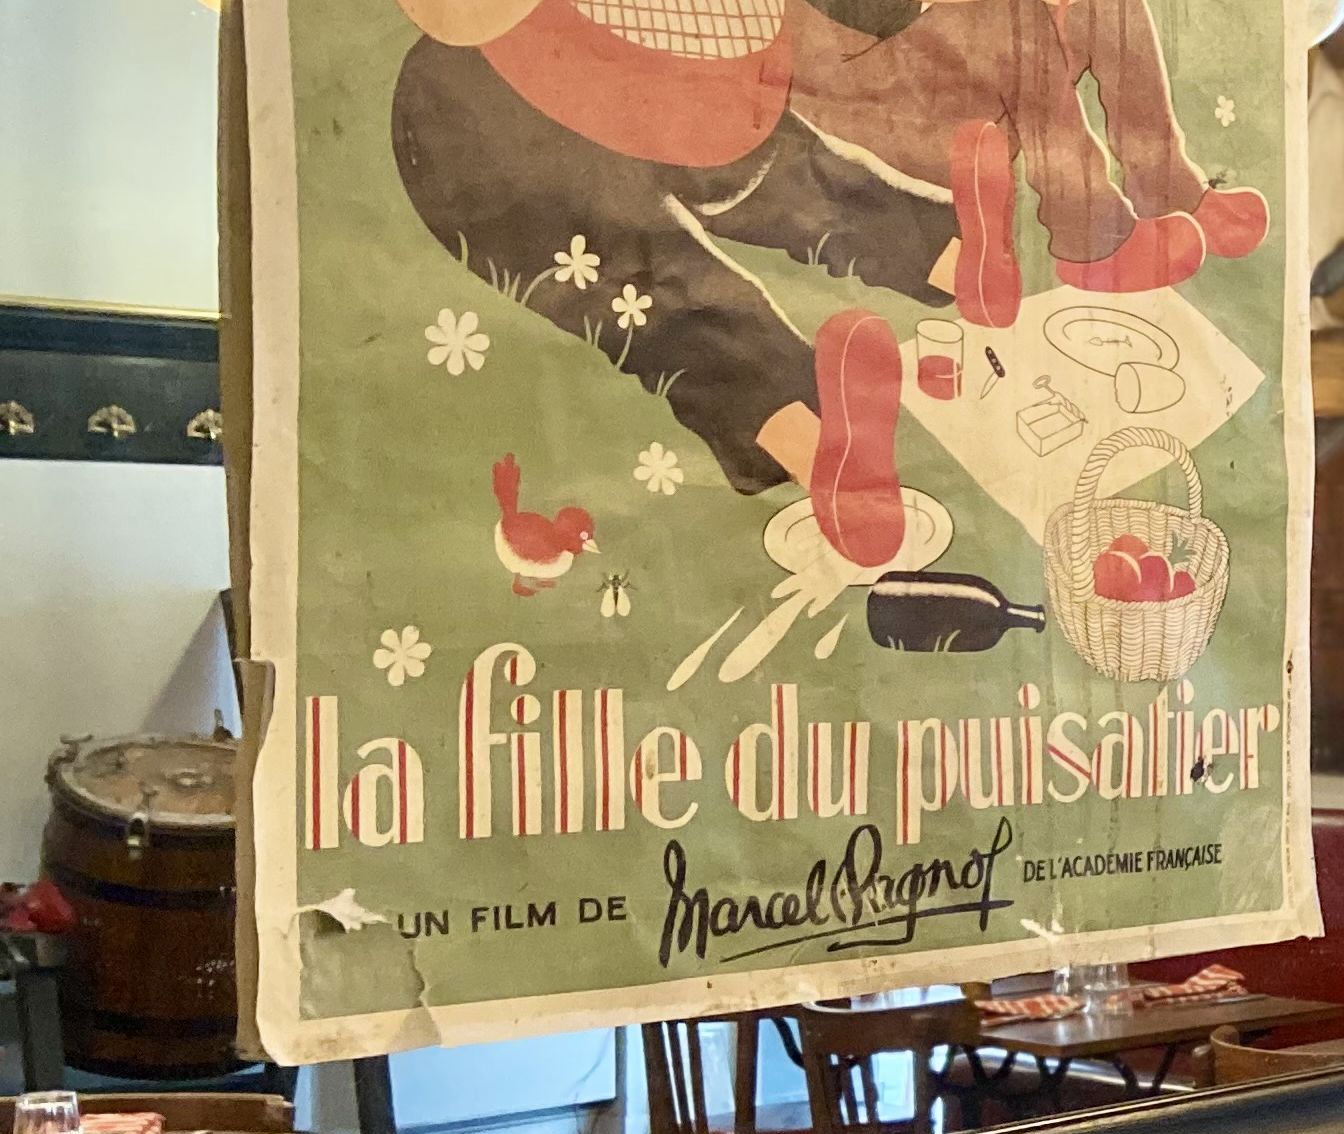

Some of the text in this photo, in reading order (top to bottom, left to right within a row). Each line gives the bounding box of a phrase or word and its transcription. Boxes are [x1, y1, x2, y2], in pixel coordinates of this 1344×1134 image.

[304, 695, 425, 851] la
[458, 641, 703, 839] fille
[724, 682, 871, 821] du
[896, 678, 1281, 846] puisatier
[398, 908, 449, 940] UN
[471, 901, 557, 933] FILM
[579, 895, 628, 925] DE
[658, 838, 830, 968] Marcel
[830, 815, 1014, 952] Pagnol
[1023, 859, 1046, 883] DE
[1147, 843, 1223, 872] FRANÇAISE
